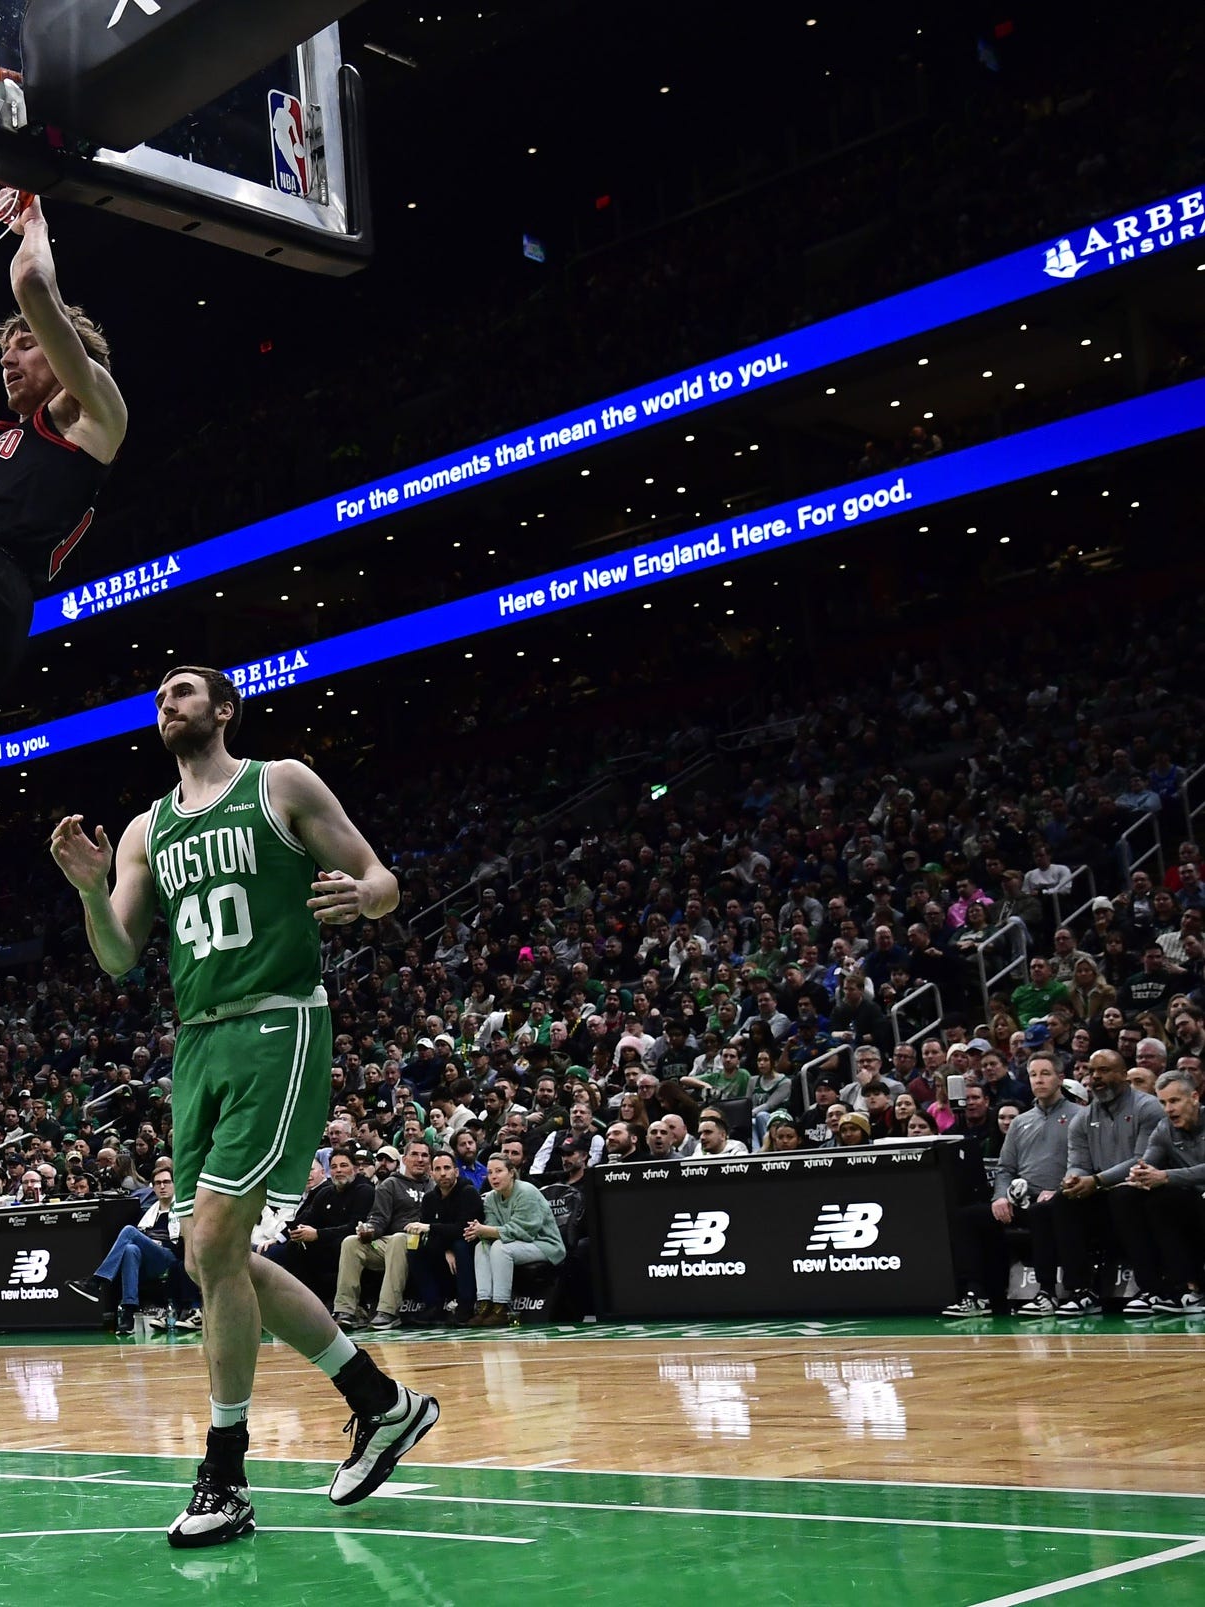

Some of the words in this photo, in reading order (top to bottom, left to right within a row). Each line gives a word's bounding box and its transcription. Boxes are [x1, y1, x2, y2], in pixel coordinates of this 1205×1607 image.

[279, 171, 297, 191] NBA
[336, 497, 366, 522] For
[369, 488, 399, 510] the
[403, 455, 492, 499] moments
[495, 436, 536, 467] that
[540, 417, 597, 453] mean
[601, 405, 637, 430] the
[642, 375, 704, 416] world
[708, 371, 733, 393] to
[738, 353, 789, 388] you.
[499, 589, 546, 617] Here
[549, 580, 578, 602] for
[583, 565, 628, 592] New
[633, 532, 726, 578] England.
[731, 518, 792, 550] Here.
[797, 503, 837, 531] For
[843, 477, 913, 522] good.
[78, 554, 181, 606] ARBELLA
[91, 579, 169, 614] INSURANCE
[224, 650, 309, 688] BELLA
[6, 741, 20, 758] to
[22, 734, 50, 757] you.
[224, 801, 255, 813] Amica
[156, 827, 257, 899] BOSTON
[176, 883, 253, 960] 40
[604, 1171, 631, 1182] xfinity
[642, 1168, 670, 1180] xfinity
[681, 1165, 709, 1178] xfinity
[721, 1163, 749, 1174] xfinity
[761, 1160, 791, 1172] xfinity
[648, 1264, 679, 1278] new
[681, 1260, 746, 1277] balance
[793, 1258, 827, 1273] new
[829, 1254, 901, 1272] balance
[1, 1289, 19, 1300] new
[20, 1287, 59, 1299] balance
